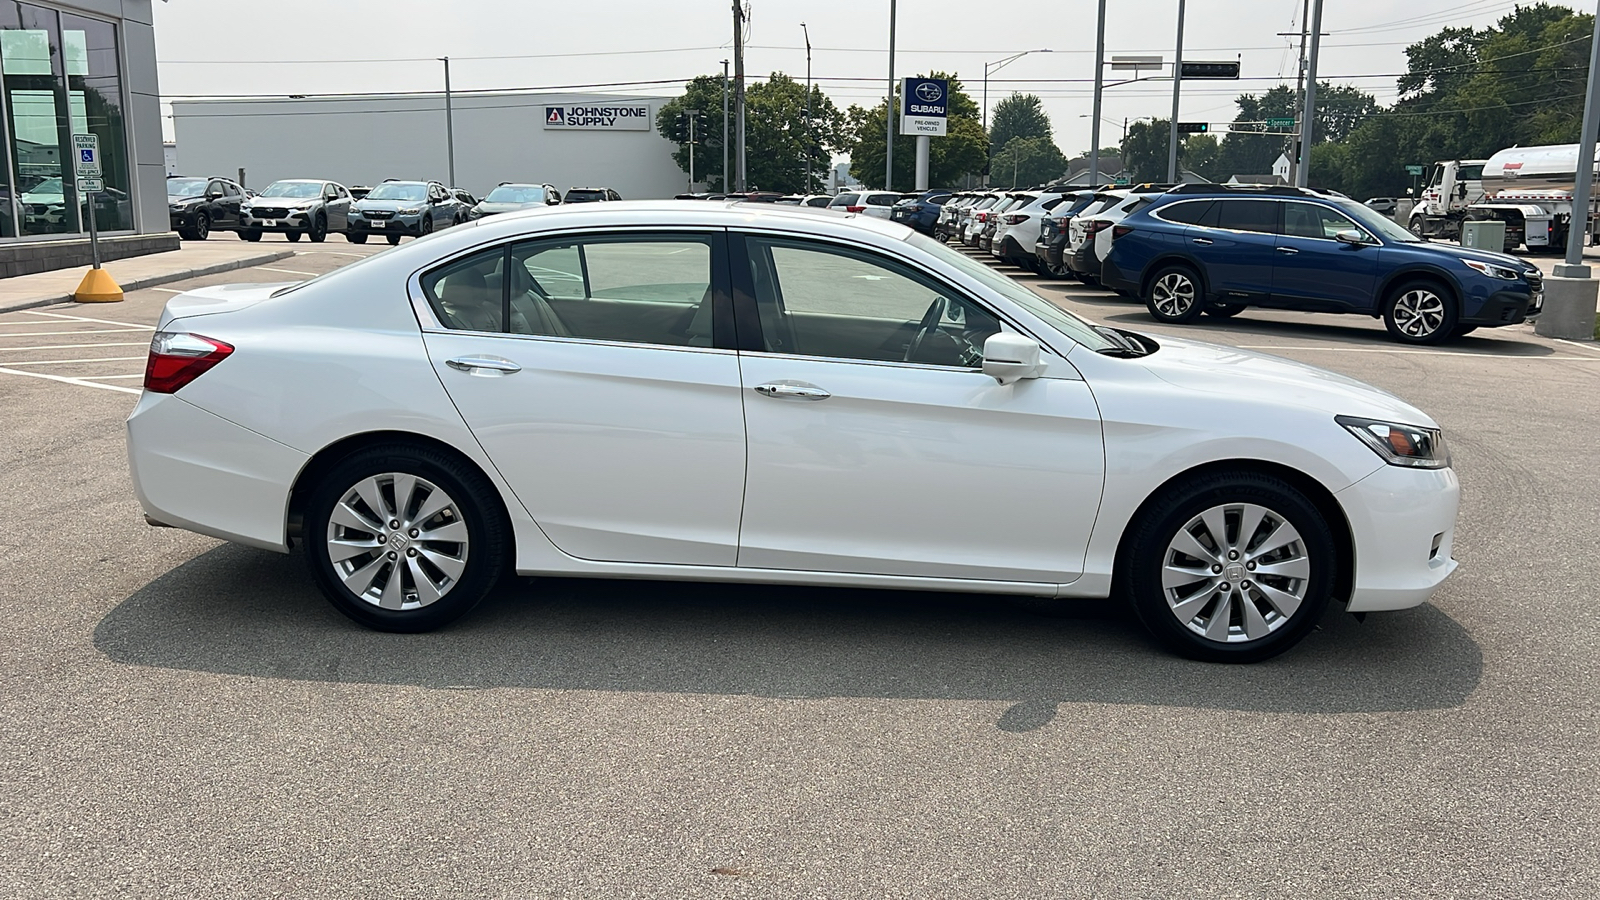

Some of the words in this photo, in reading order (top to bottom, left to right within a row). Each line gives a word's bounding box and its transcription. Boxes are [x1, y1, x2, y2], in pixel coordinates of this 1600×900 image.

[567, 107, 646, 117] JOHNSTONE
[910, 104, 945, 114] SUBARU
[567, 117, 616, 126] SUPPLY
[1270, 119, 1291, 127] Spencer
